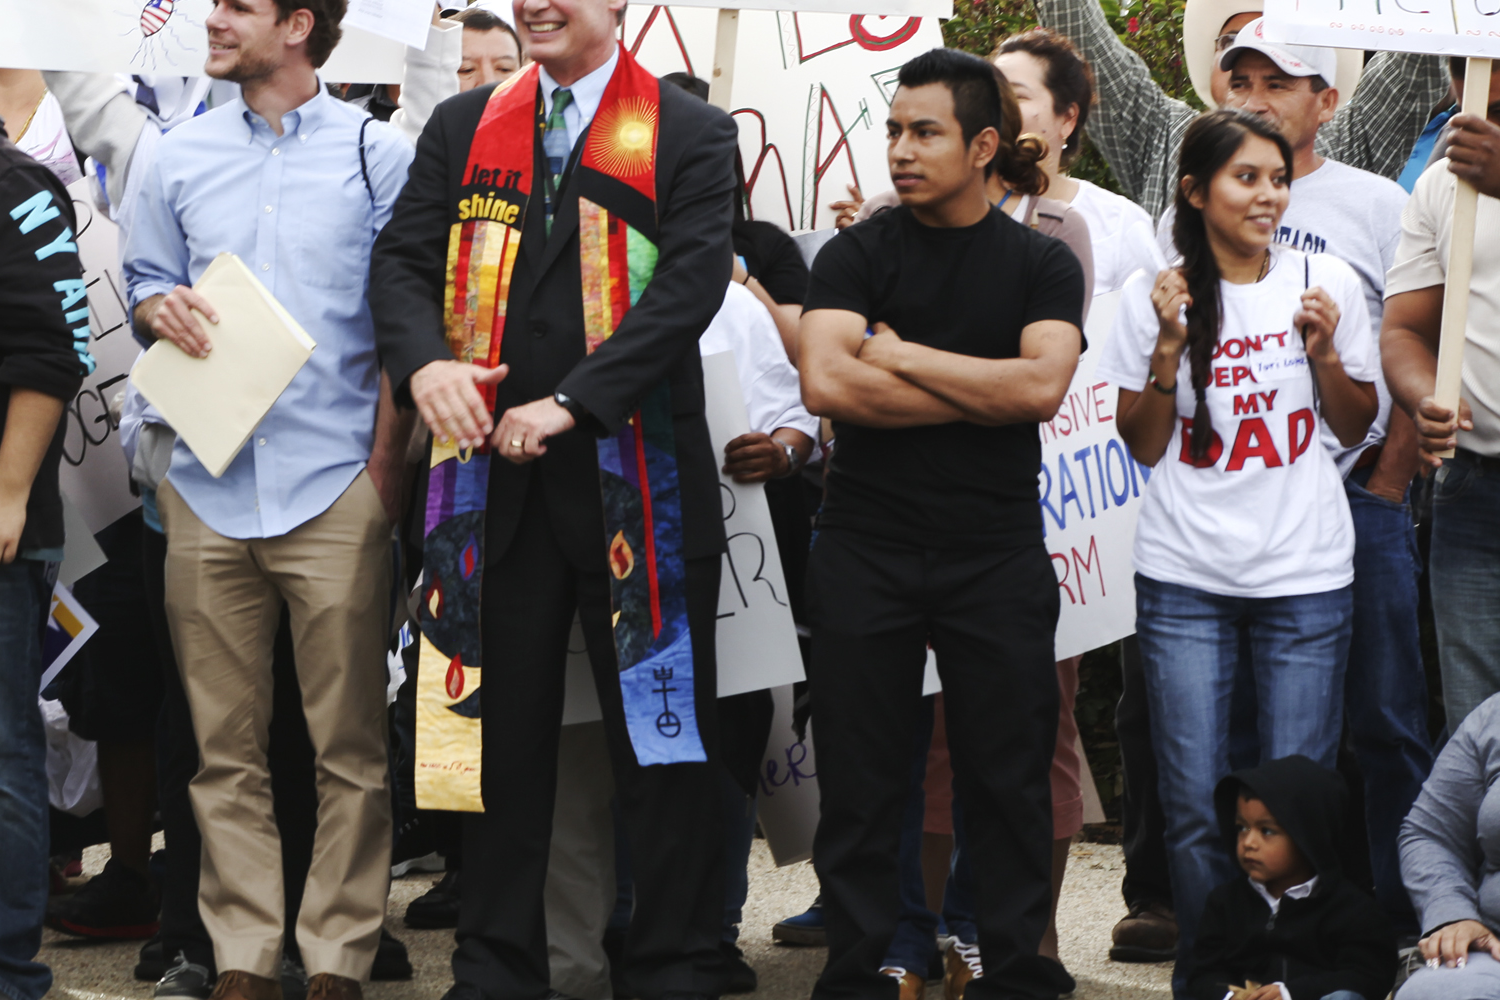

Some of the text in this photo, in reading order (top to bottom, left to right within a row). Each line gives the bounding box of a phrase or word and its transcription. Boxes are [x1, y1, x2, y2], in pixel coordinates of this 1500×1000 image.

[471, 163, 523, 190] let it
[458, 190, 520, 225] shine
[1040, 380, 1114, 445] NSIVE
[1233, 388, 1278, 416] MY
[1038, 437, 1153, 540] RATION
